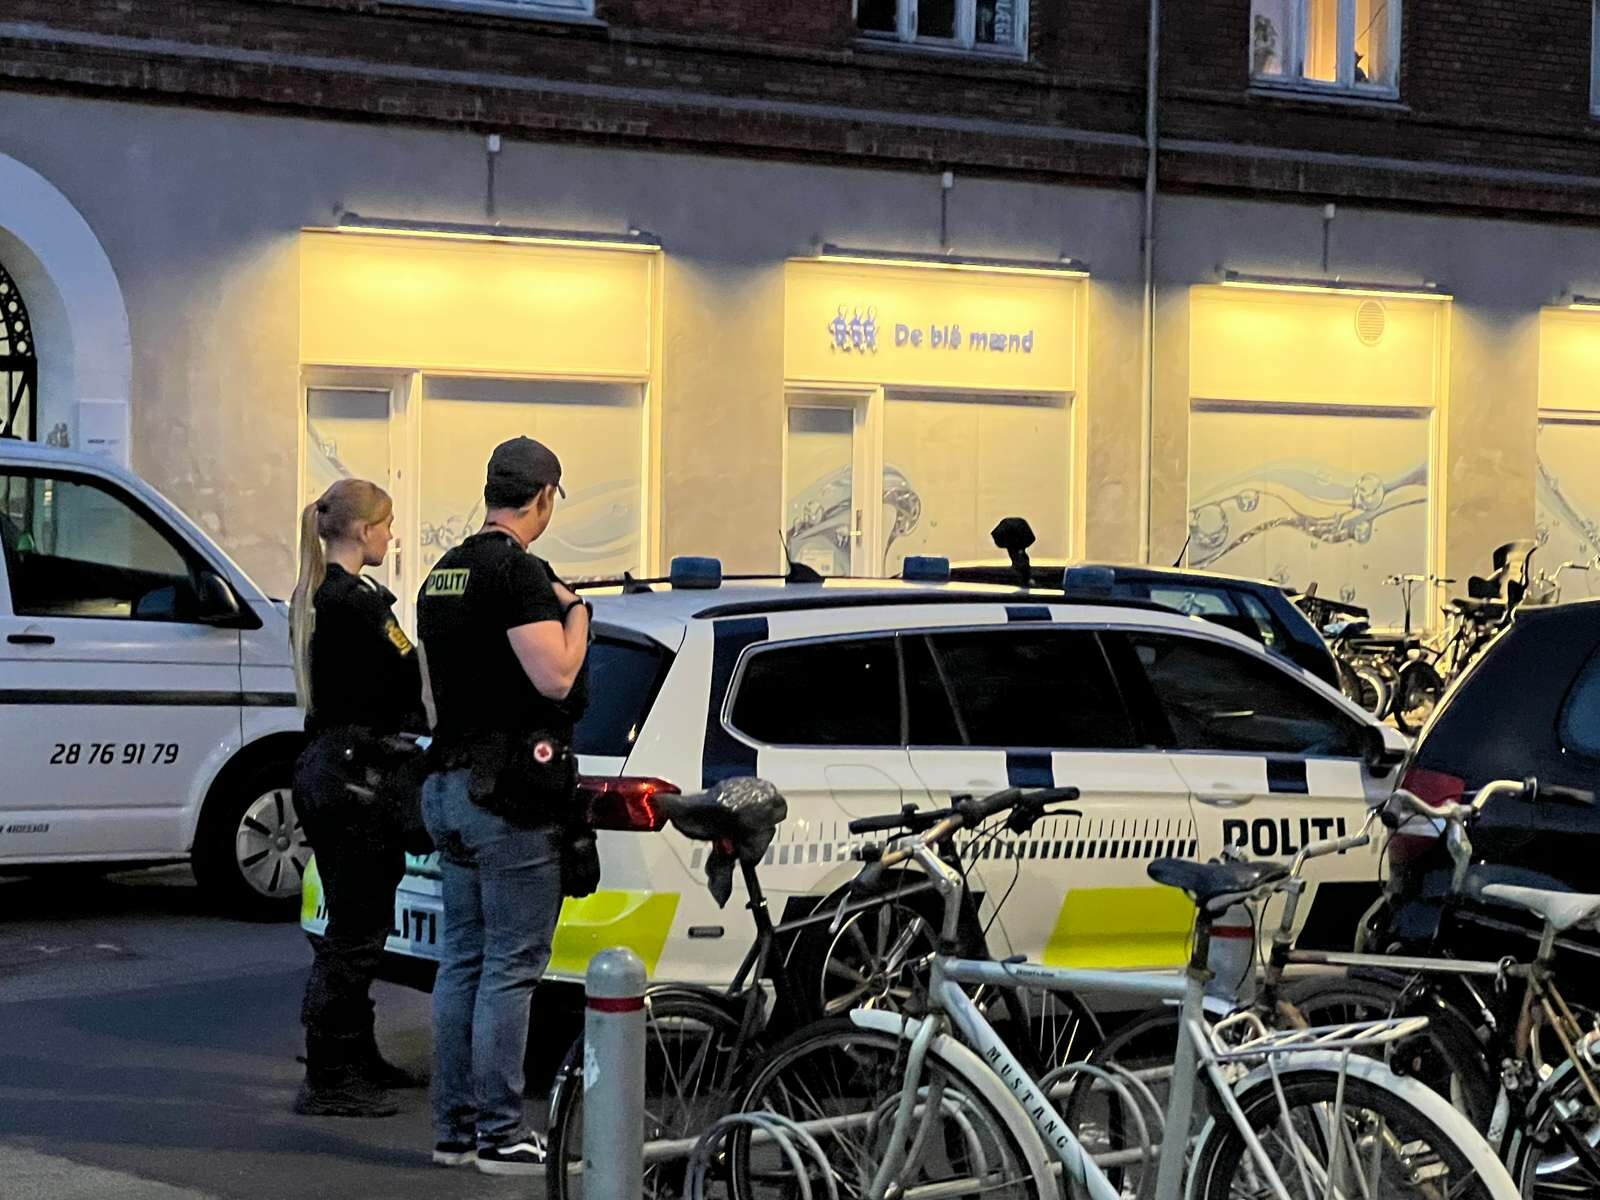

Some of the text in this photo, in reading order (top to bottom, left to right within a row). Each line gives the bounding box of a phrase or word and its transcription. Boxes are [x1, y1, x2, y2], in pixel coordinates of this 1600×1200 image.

[895, 324, 1034, 354] De blå mænd
[427, 573, 468, 591] POLITI
[50, 743, 180, 765] 28 76 91 79
[1222, 817, 1346, 856] POLITI
[985, 1045, 1069, 1150] MUSTANG
